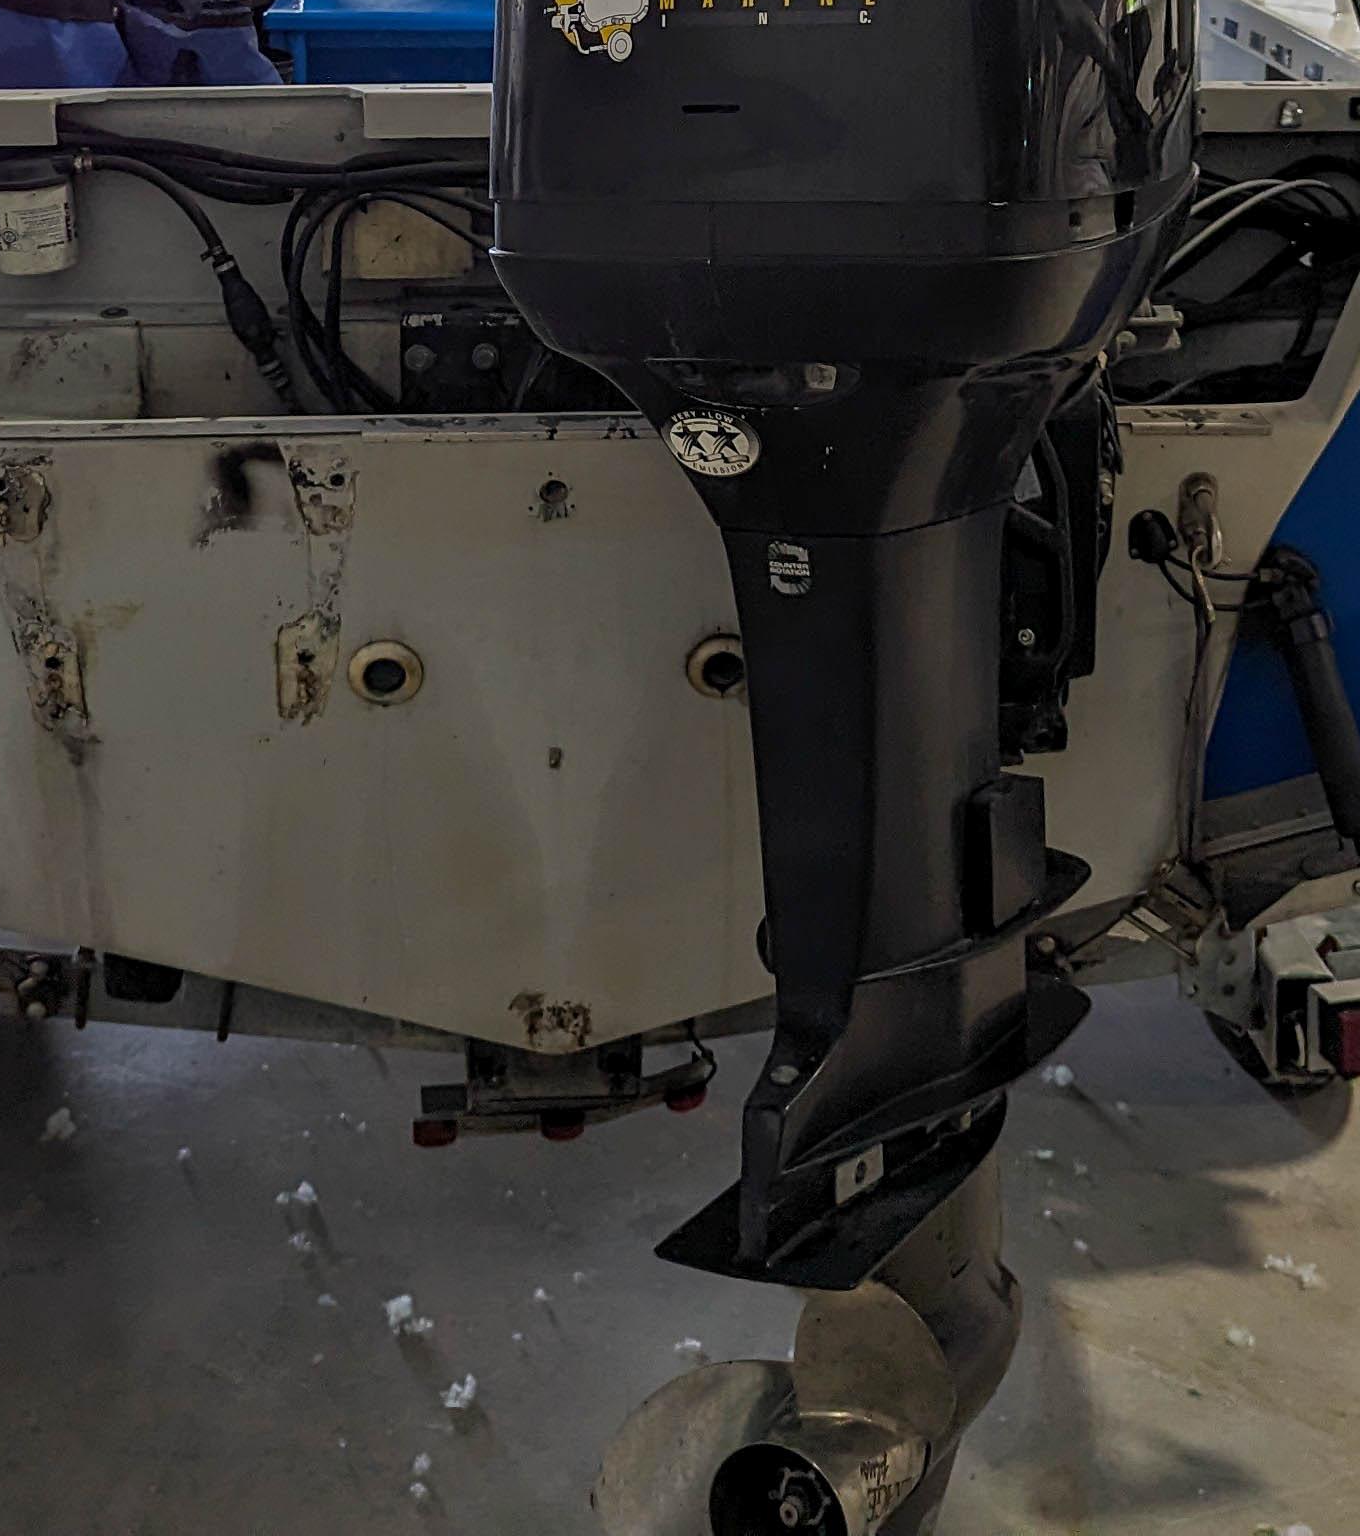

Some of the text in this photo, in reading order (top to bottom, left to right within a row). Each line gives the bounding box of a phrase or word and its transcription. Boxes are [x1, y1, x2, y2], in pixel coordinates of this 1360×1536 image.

[671, 410, 734, 424] VERY LOW
[692, 462, 745, 474] EMISSION
[768, 560, 809, 569] COUNTER
[769, 567, 810, 576] ROTATION
